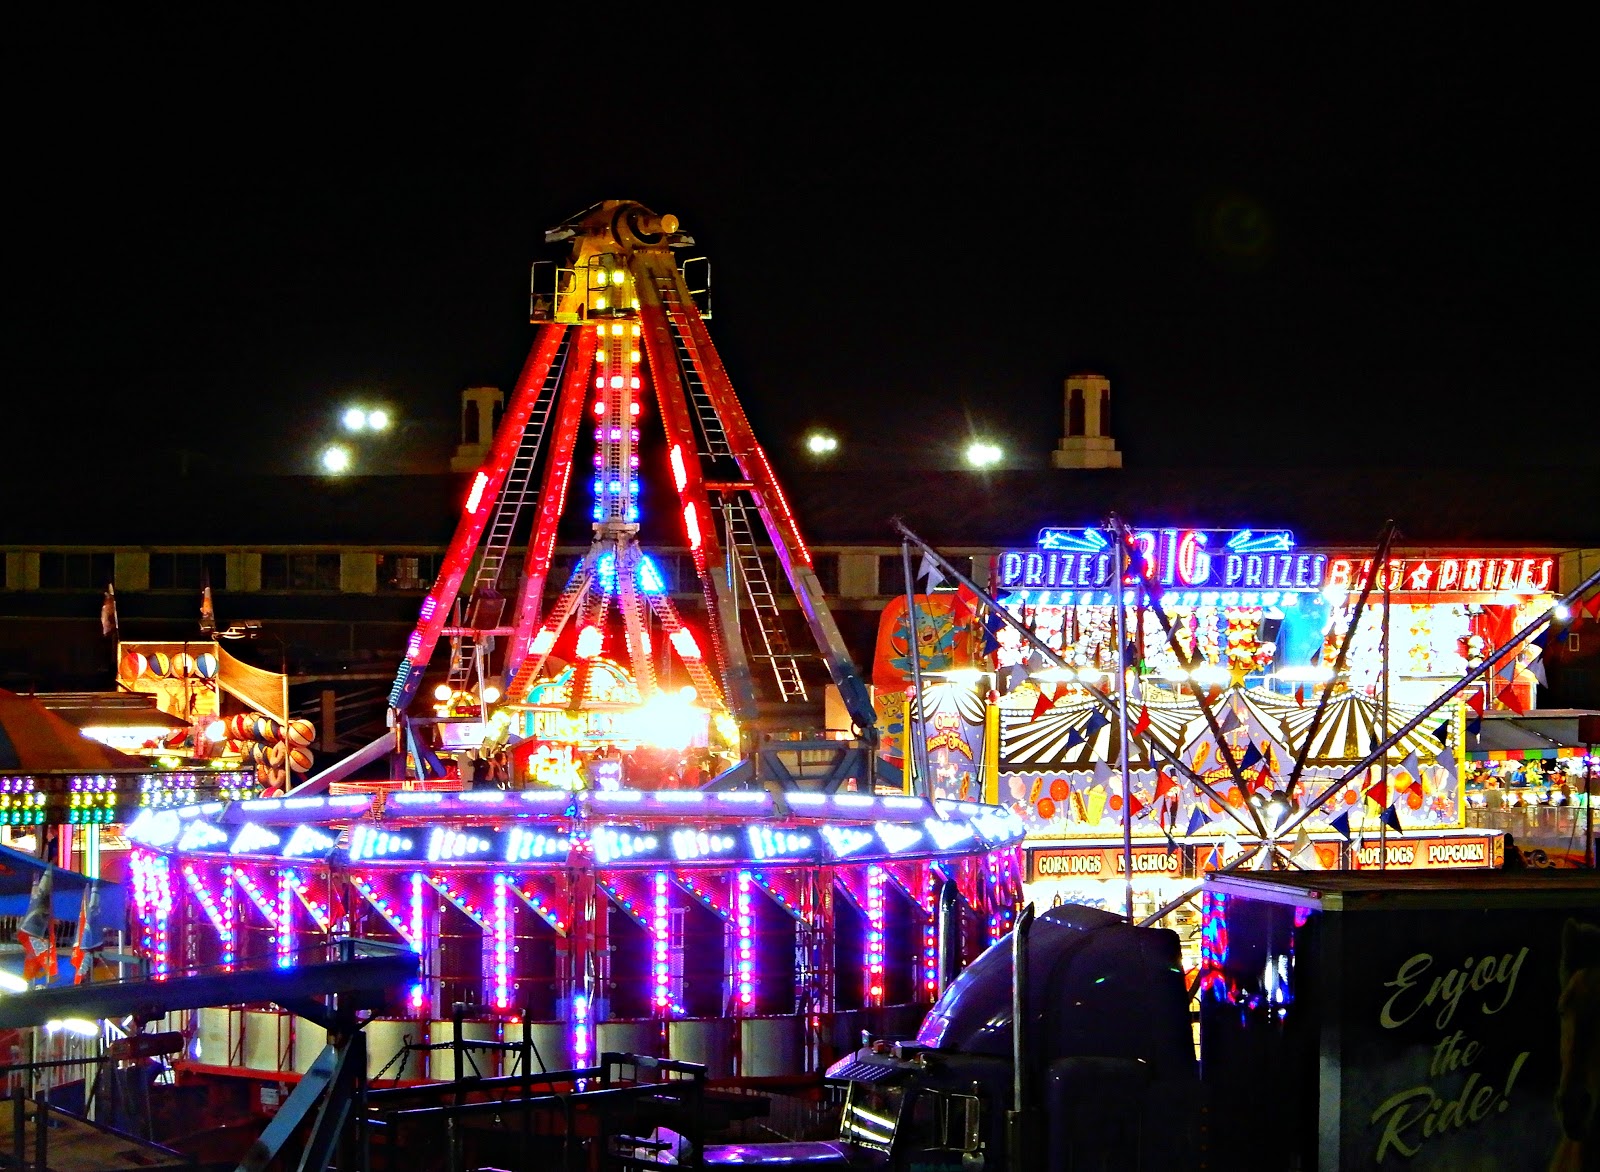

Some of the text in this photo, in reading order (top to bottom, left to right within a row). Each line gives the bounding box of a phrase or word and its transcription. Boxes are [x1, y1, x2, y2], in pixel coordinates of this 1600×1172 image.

[1003, 553, 1109, 586] PRIZES
[1225, 555, 1325, 587] PRIZES
[1439, 558, 1553, 591] PRIZES
[1038, 853, 1178, 874] CORN DOGS NACHOS
[1428, 843, 1485, 863] POPCORN
[1379, 946, 1530, 1030] Enjoy
[1429, 1029, 1484, 1078] the
[1369, 1051, 1531, 1165] Ride!
